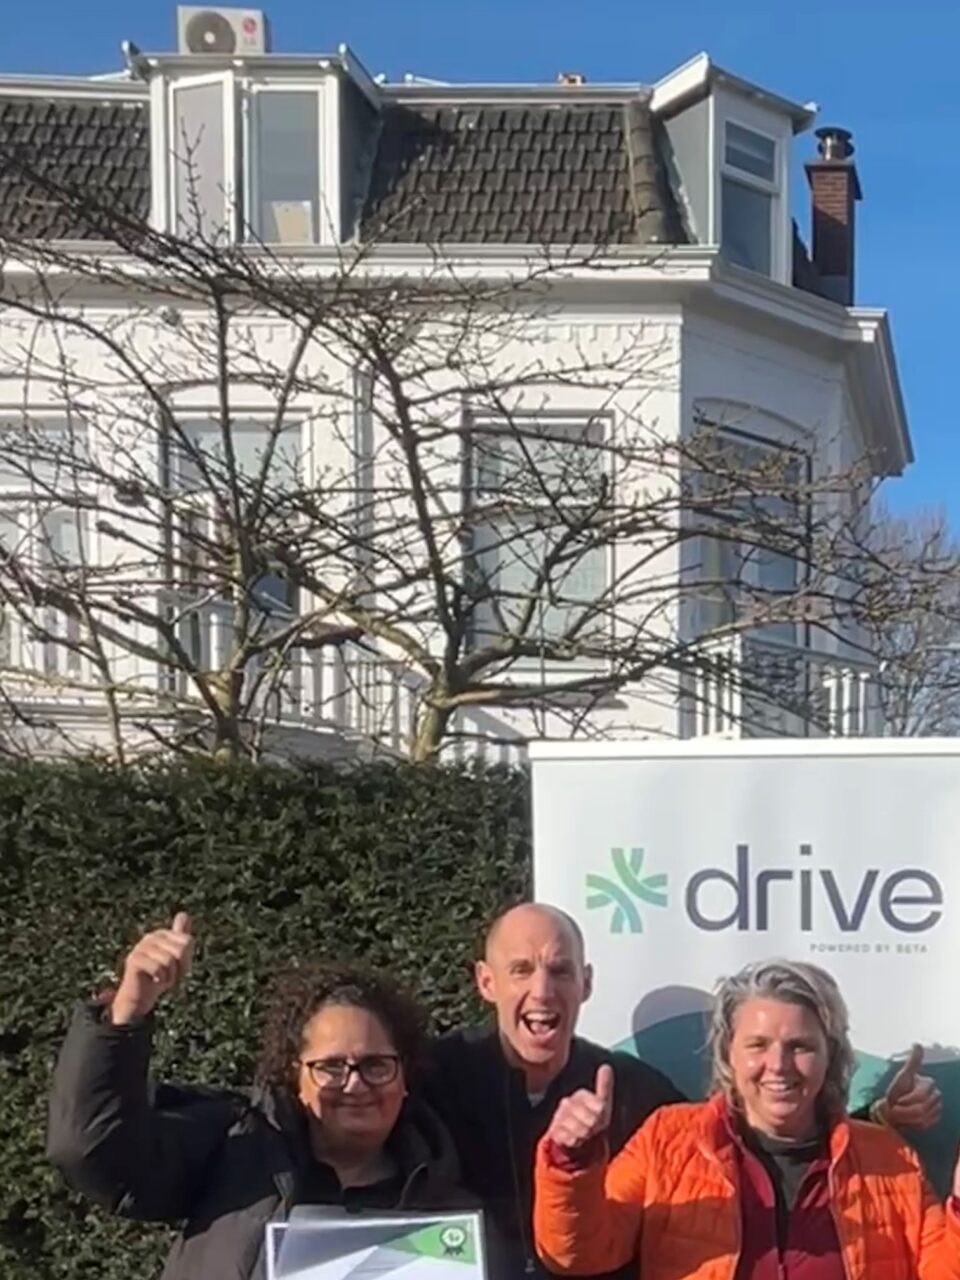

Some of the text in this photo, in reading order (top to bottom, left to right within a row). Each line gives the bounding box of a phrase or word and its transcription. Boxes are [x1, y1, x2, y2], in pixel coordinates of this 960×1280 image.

[686, 844, 942, 932] drive
[809, 943, 870, 953] POWERED
[875, 943, 891, 953] BY
